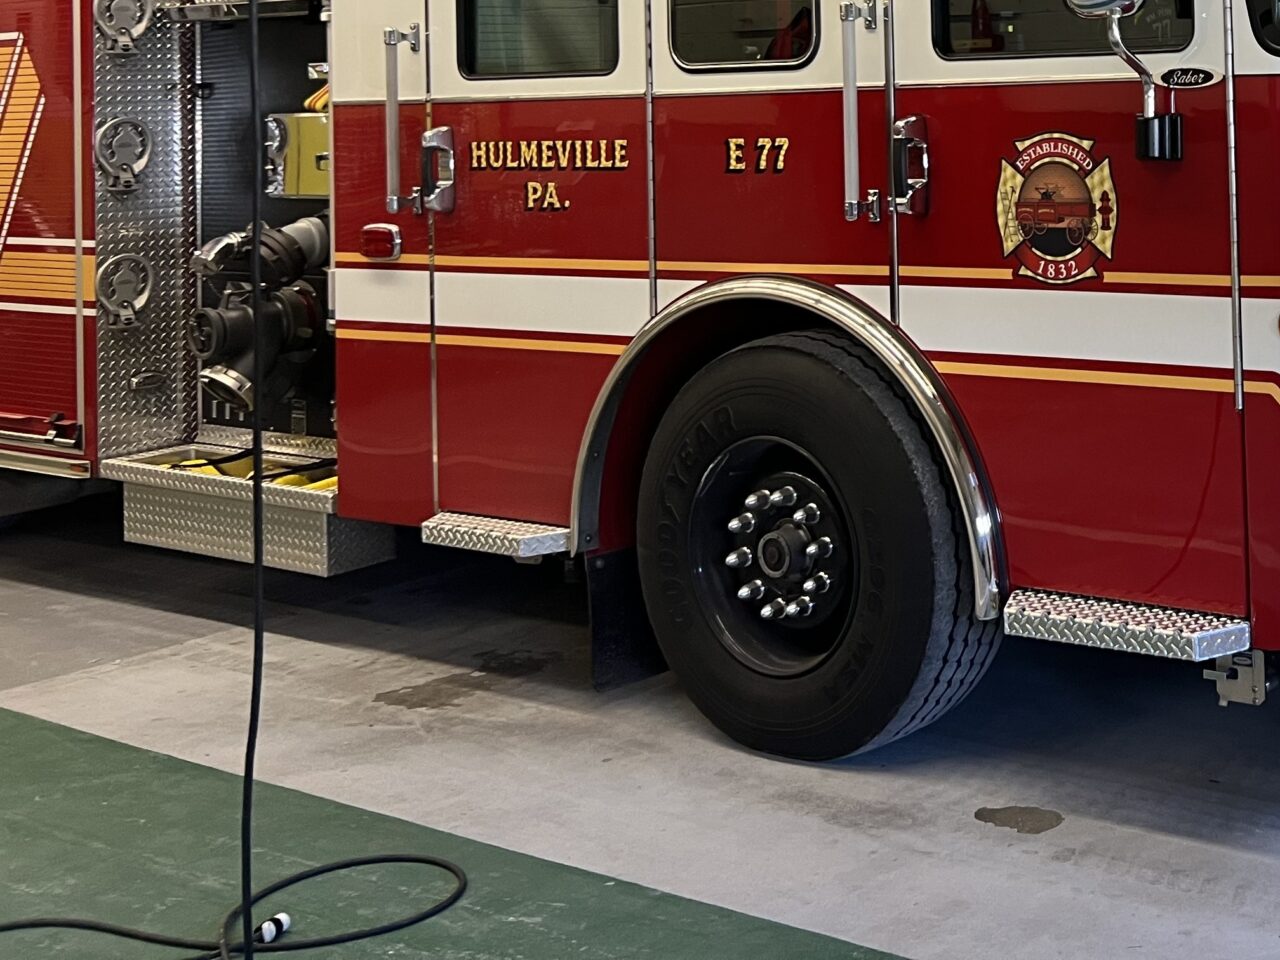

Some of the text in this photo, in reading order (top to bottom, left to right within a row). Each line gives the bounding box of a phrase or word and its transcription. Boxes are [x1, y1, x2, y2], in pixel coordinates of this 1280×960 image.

[1169, 70, 1205, 85] Saber
[470, 139, 629, 170] HULMEVILLE
[725, 137, 789, 172] E 77
[1015, 142, 1093, 170] ESTABLISHED
[526, 181, 571, 210] PA.
[1037, 260, 1079, 279] 1832
